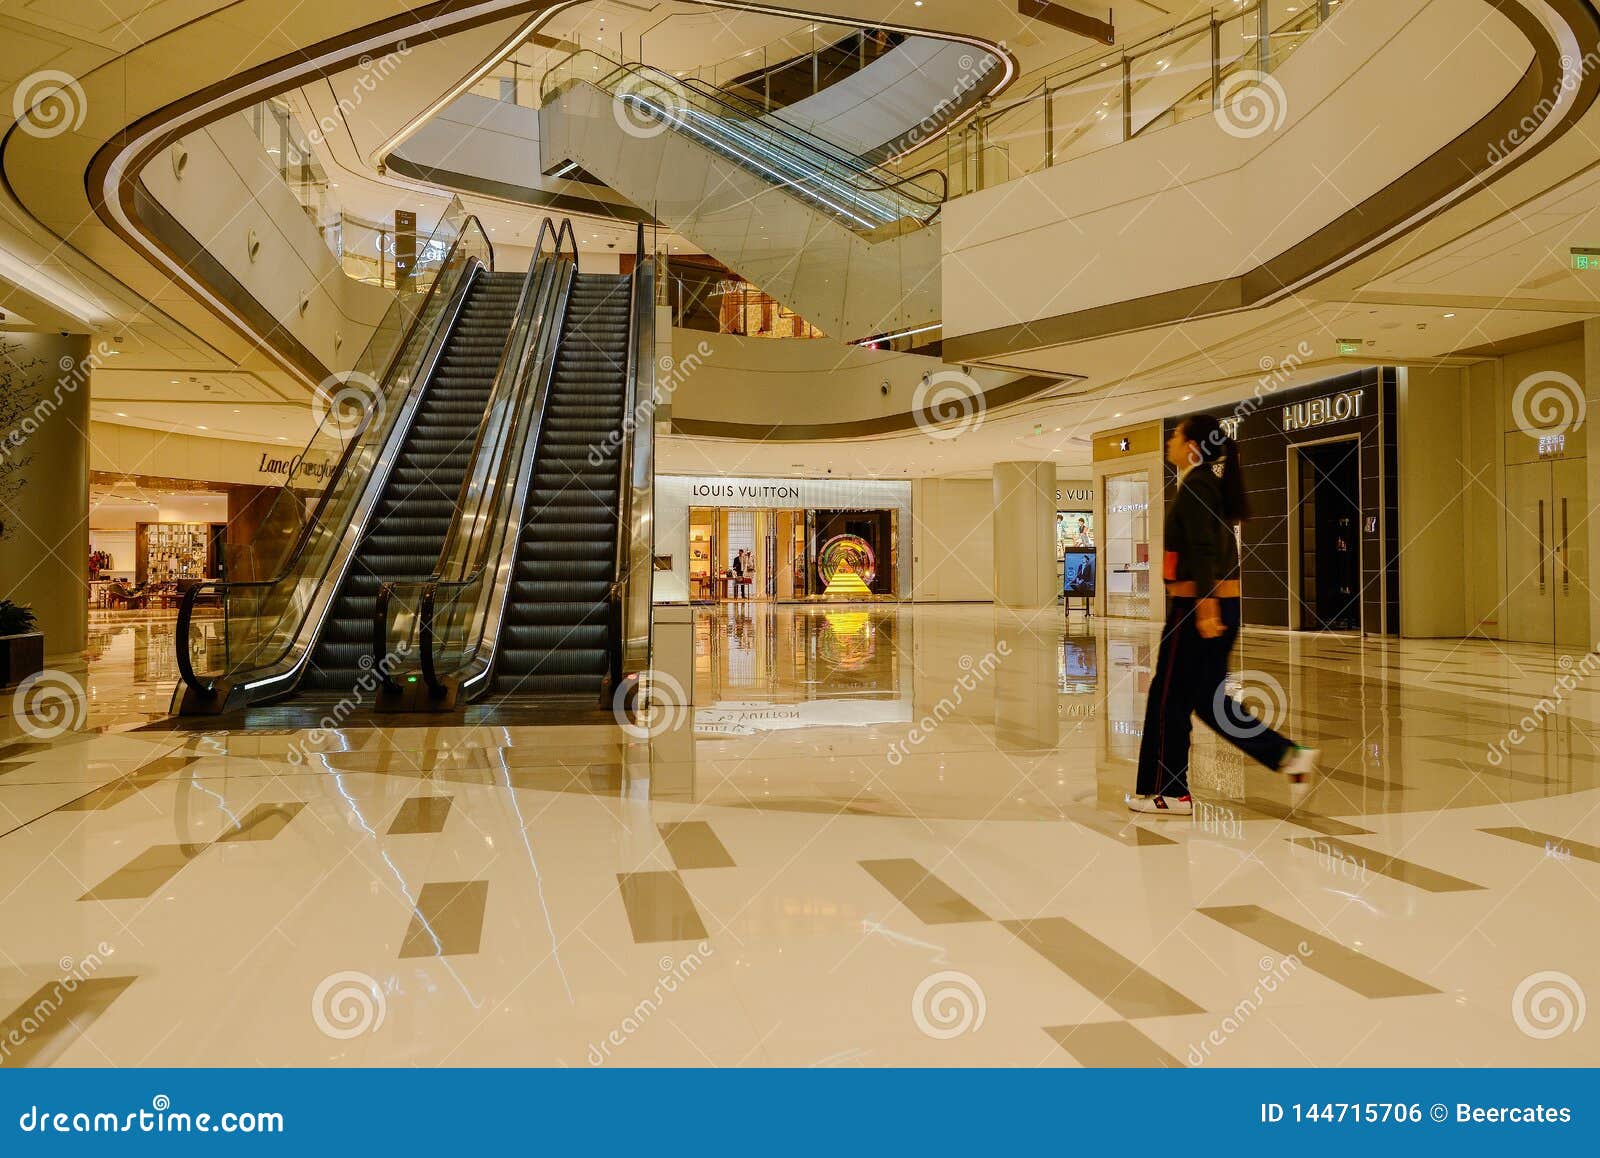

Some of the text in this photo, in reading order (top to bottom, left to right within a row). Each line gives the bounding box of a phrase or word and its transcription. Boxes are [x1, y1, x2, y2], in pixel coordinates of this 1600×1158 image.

[1282, 389, 1364, 432] HUBLOT
[259, 453, 290, 475] Lane
[693, 484, 800, 499] LOUIS VUITTON
[1066, 489, 1094, 501] VUIT
